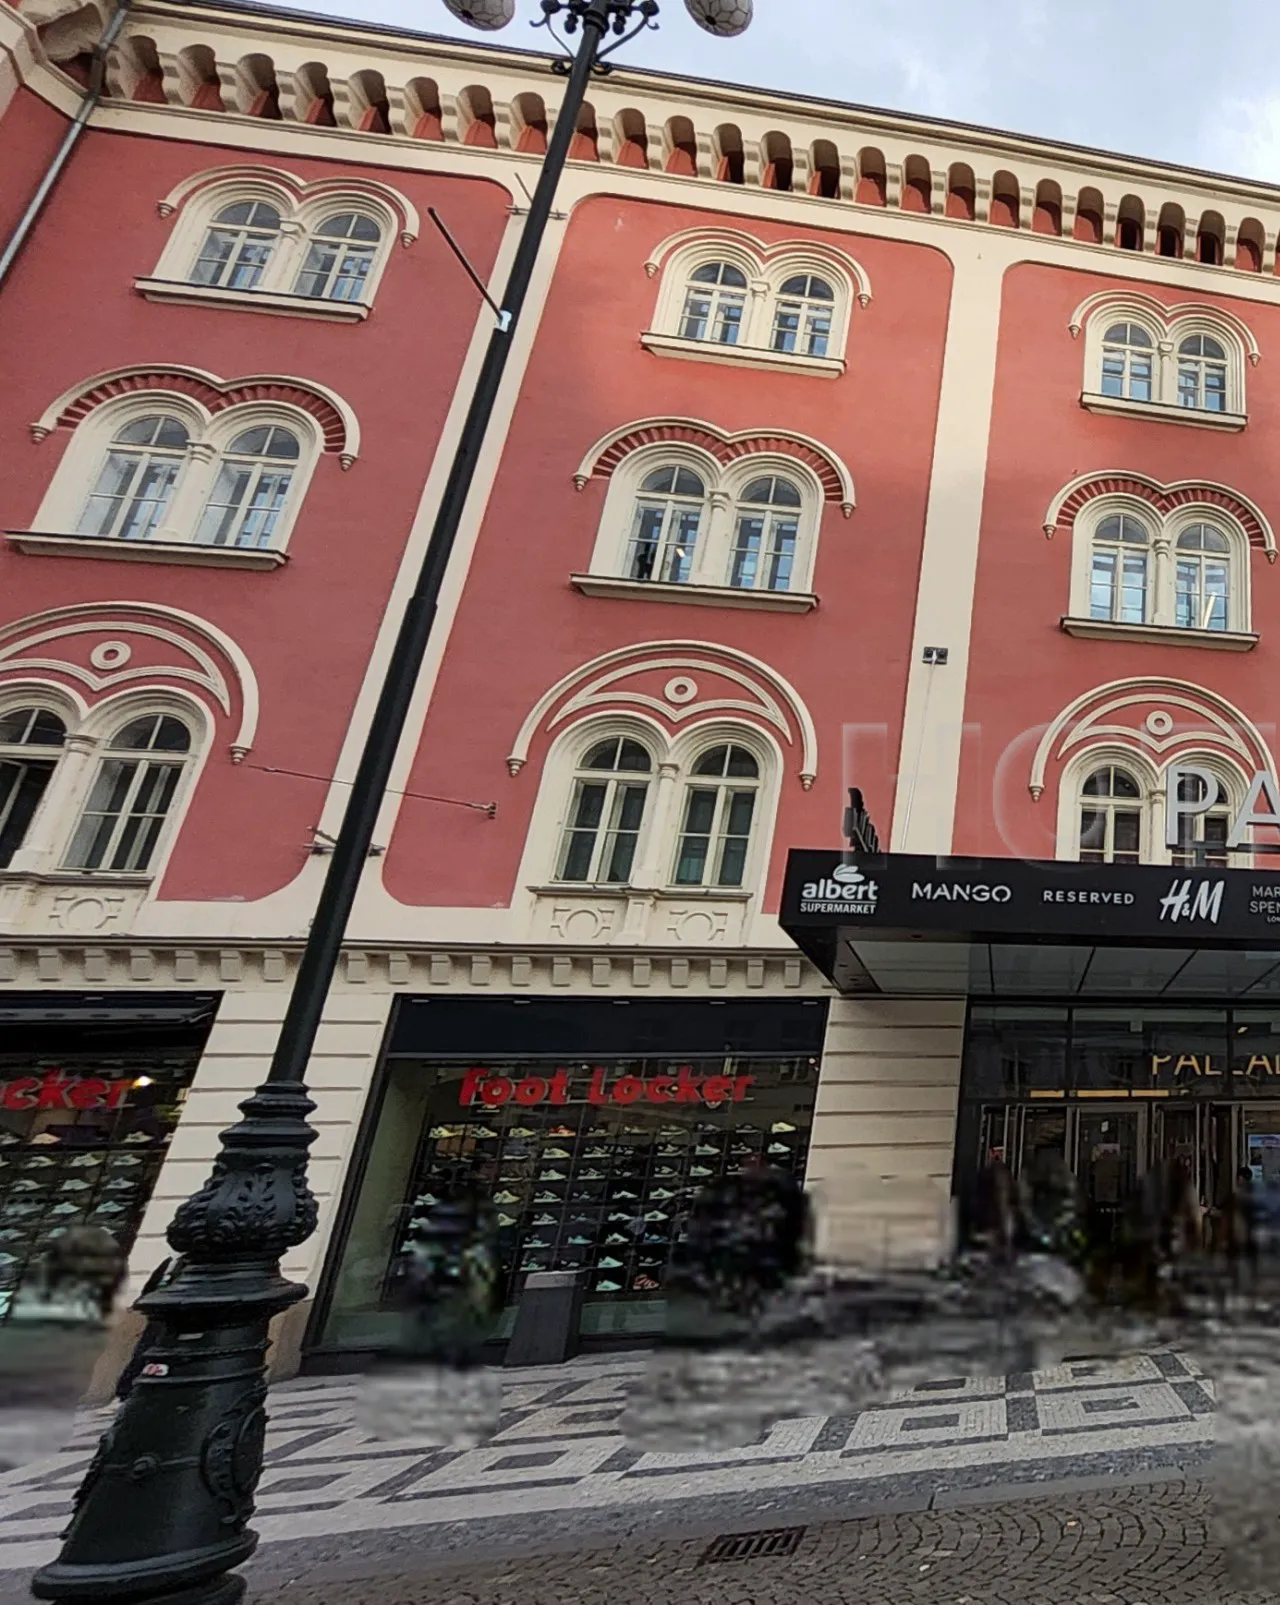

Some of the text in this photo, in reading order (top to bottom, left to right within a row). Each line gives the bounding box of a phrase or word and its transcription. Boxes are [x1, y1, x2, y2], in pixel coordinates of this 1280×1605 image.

[801, 878, 879, 900] albert
[911, 882, 1012, 902] MANGO
[1043, 890, 1135, 905] RESERVED
[800, 902, 877, 914] SUPERMARKET
[1159, 879, 1225, 924] H&M
[588, 1066, 757, 1105] Locker
